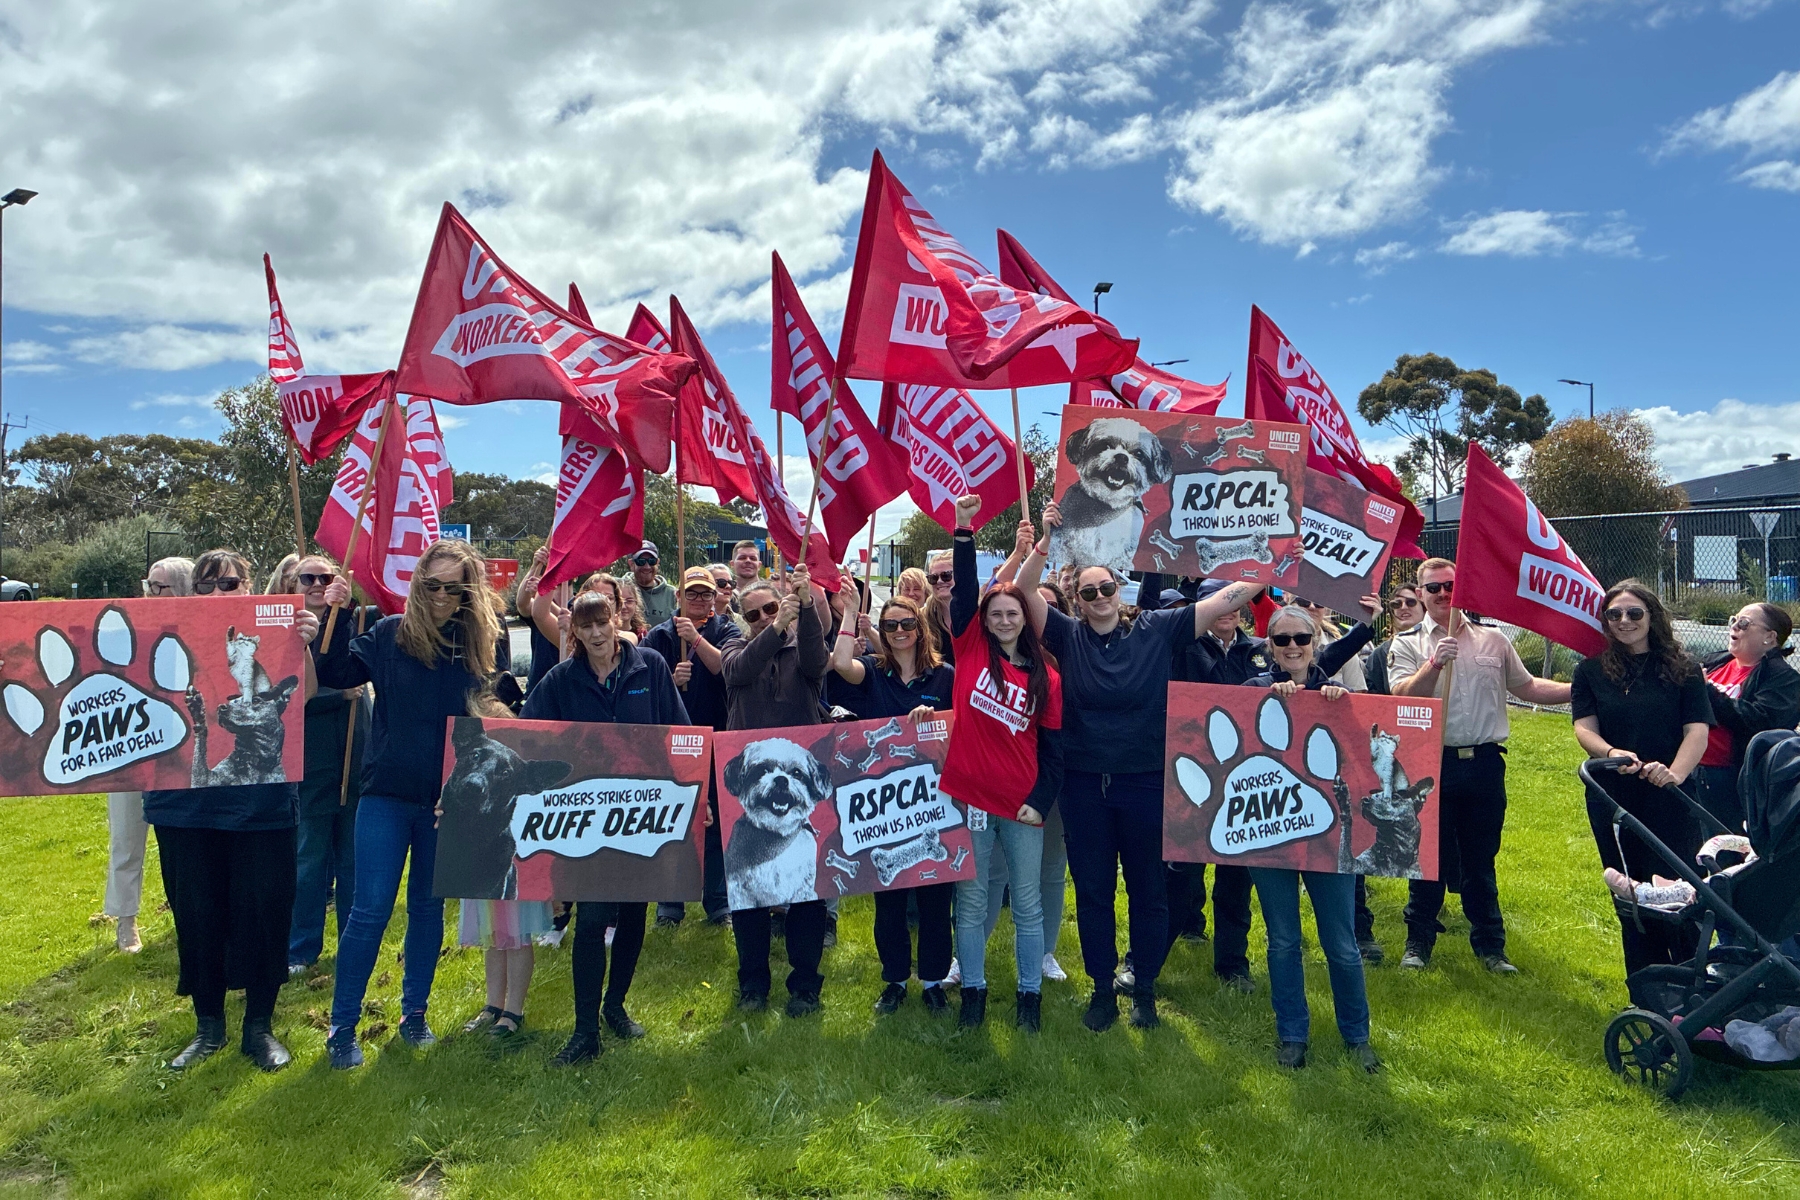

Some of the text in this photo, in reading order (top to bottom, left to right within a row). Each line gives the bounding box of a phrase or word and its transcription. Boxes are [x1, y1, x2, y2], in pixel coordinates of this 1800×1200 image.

[281, 386, 334, 425] NION
[1269, 430, 1301, 443] UNITED
[1181, 480, 1278, 512] RSPCA:
[1368, 499, 1397, 518] UNITED
[1183, 513, 1280, 530] THROW US A BONE!
[1300, 516, 1354, 541] STRIKE OVER
[1302, 531, 1371, 568] DEAL!
[255, 603, 294, 617] UNITED
[67, 687, 126, 718] WORKERS
[972, 694, 1005, 719] WORKERS
[1397, 705, 1433, 719] UNITED
[62, 698, 150, 755] PAWS
[672, 734, 704, 747] UNITED
[916, 719, 947, 734] UNITED
[60, 729, 164, 775] FOR A FAIR DEAL!
[1231, 770, 1283, 793] WORKERS
[543, 788, 662, 808] WORKERS STRIKE OVER
[848, 775, 937, 825] RSPCA:
[1226, 782, 1303, 828] PAWS
[520, 803, 685, 841] RUFF DEAL!
[853, 805, 946, 844] THROW US A BONE!
[1225, 813, 1315, 846] FOR A FAIR DEAL!
